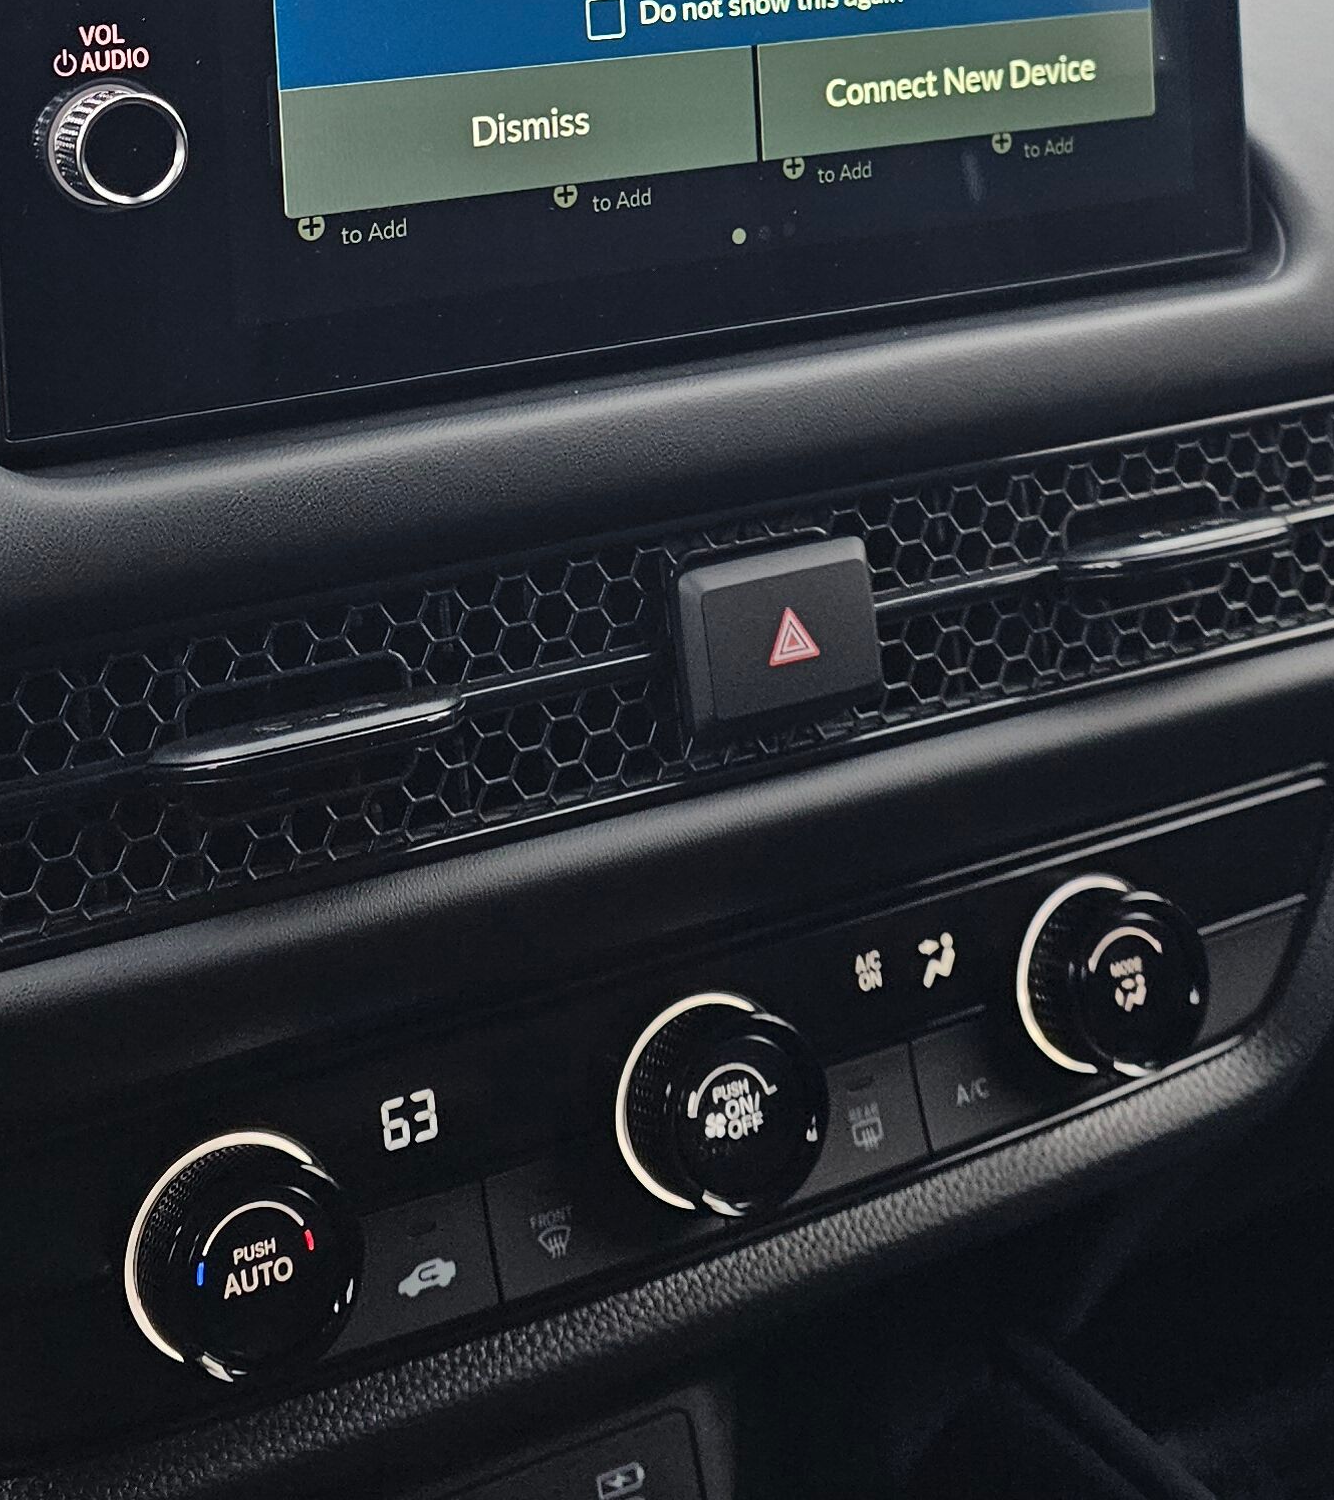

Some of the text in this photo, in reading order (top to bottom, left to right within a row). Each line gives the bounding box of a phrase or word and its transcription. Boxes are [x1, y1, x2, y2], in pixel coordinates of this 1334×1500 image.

[639, 0, 677, 26] Do
[78, 23, 125, 46] VOL
[80, 47, 149, 73] AUDIO
[825, 54, 1097, 108] Connect New Device
[472, 107, 590, 148] Dismiss
[1024, 136, 1074, 158] to Add
[817, 160, 873, 184] to Add
[592, 187, 652, 213] to Add
[340, 218, 408, 245] to Add
[855, 950, 882, 975] A/C
[858, 970, 883, 992] ON
[712, 1078, 750, 1105] PUSH
[956, 1077, 990, 1107] A/C
[380, 1088, 438, 1151] 63
[727, 1110, 764, 1140] OFF
[530, 1205, 574, 1230] FRONT
[233, 1237, 277, 1266] PUSH
[223, 1256, 294, 1300] AUTO
